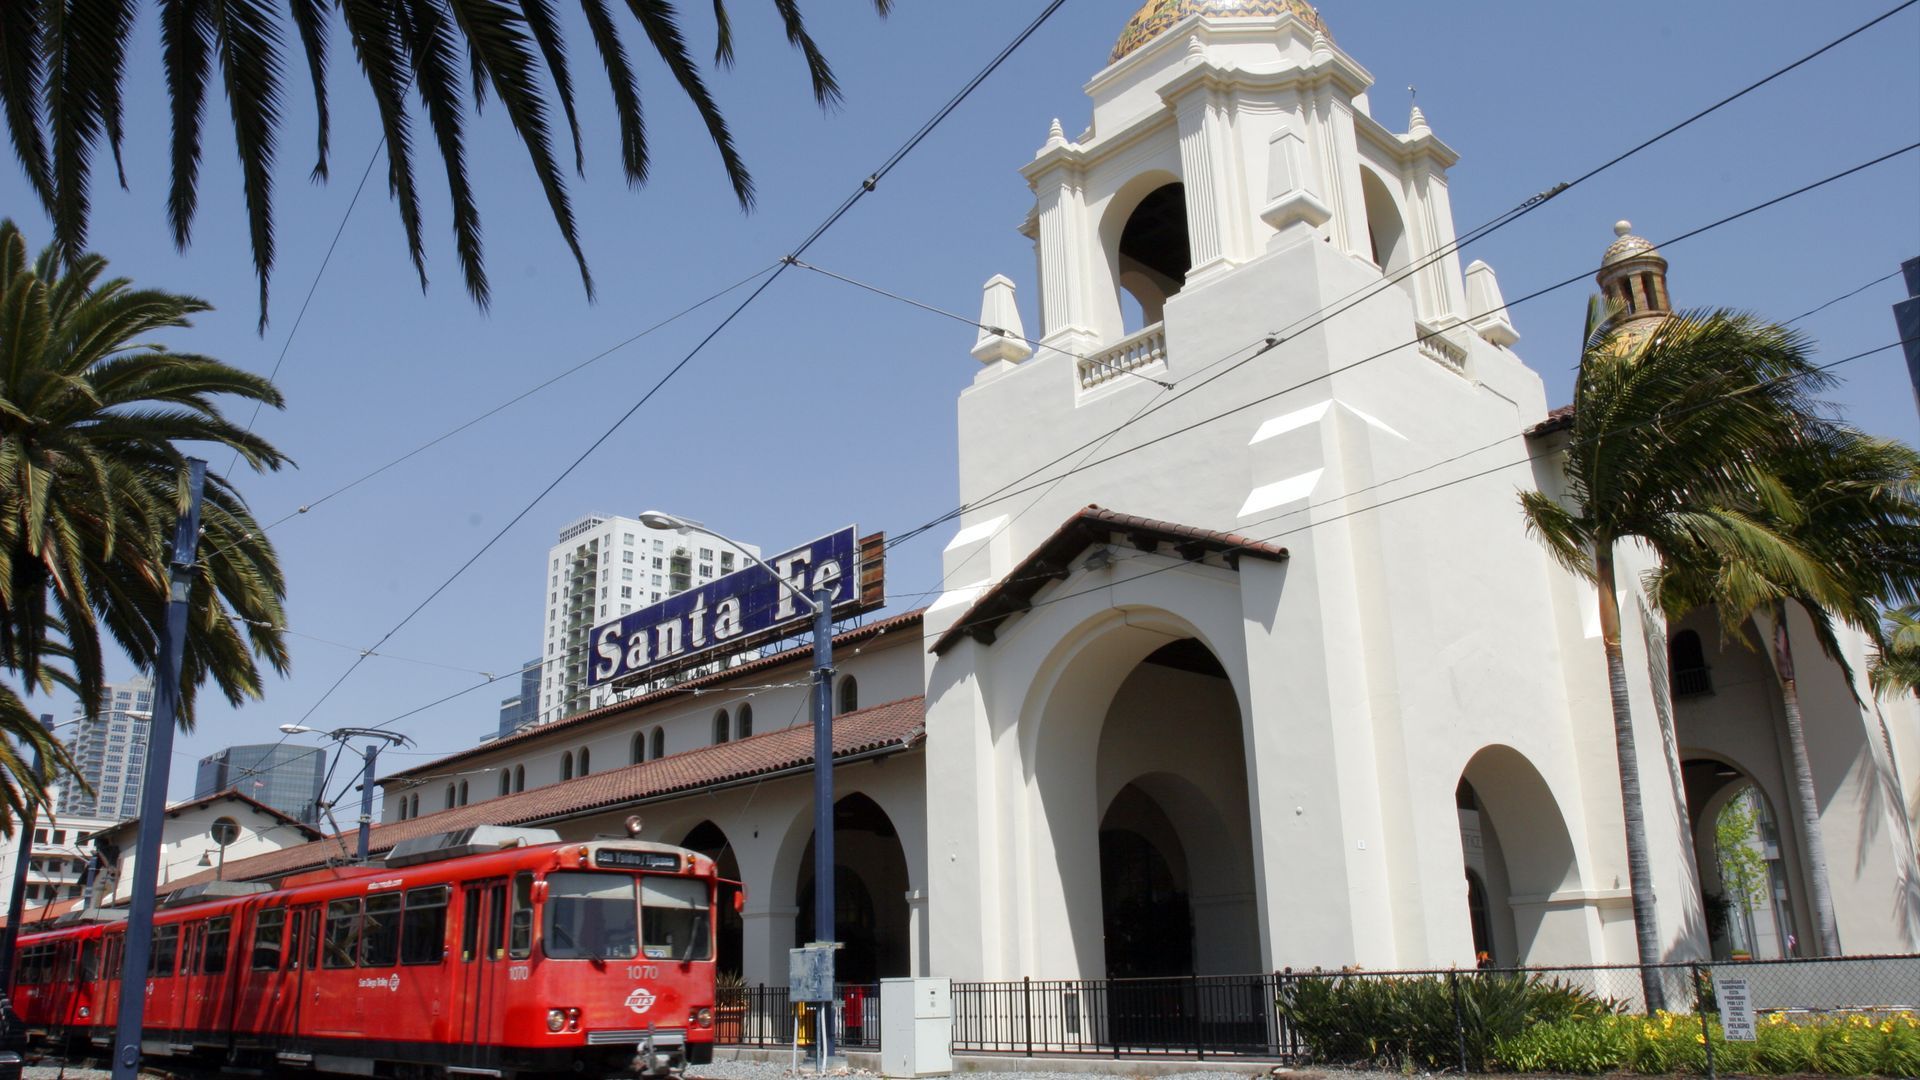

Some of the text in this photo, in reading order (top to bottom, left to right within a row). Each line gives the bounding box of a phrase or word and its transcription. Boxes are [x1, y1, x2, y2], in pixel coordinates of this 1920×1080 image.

[595, 547, 842, 682] Santa Fe
[598, 851, 614, 862] San
[508, 963, 528, 980] 1070
[625, 965, 658, 979] 1070
